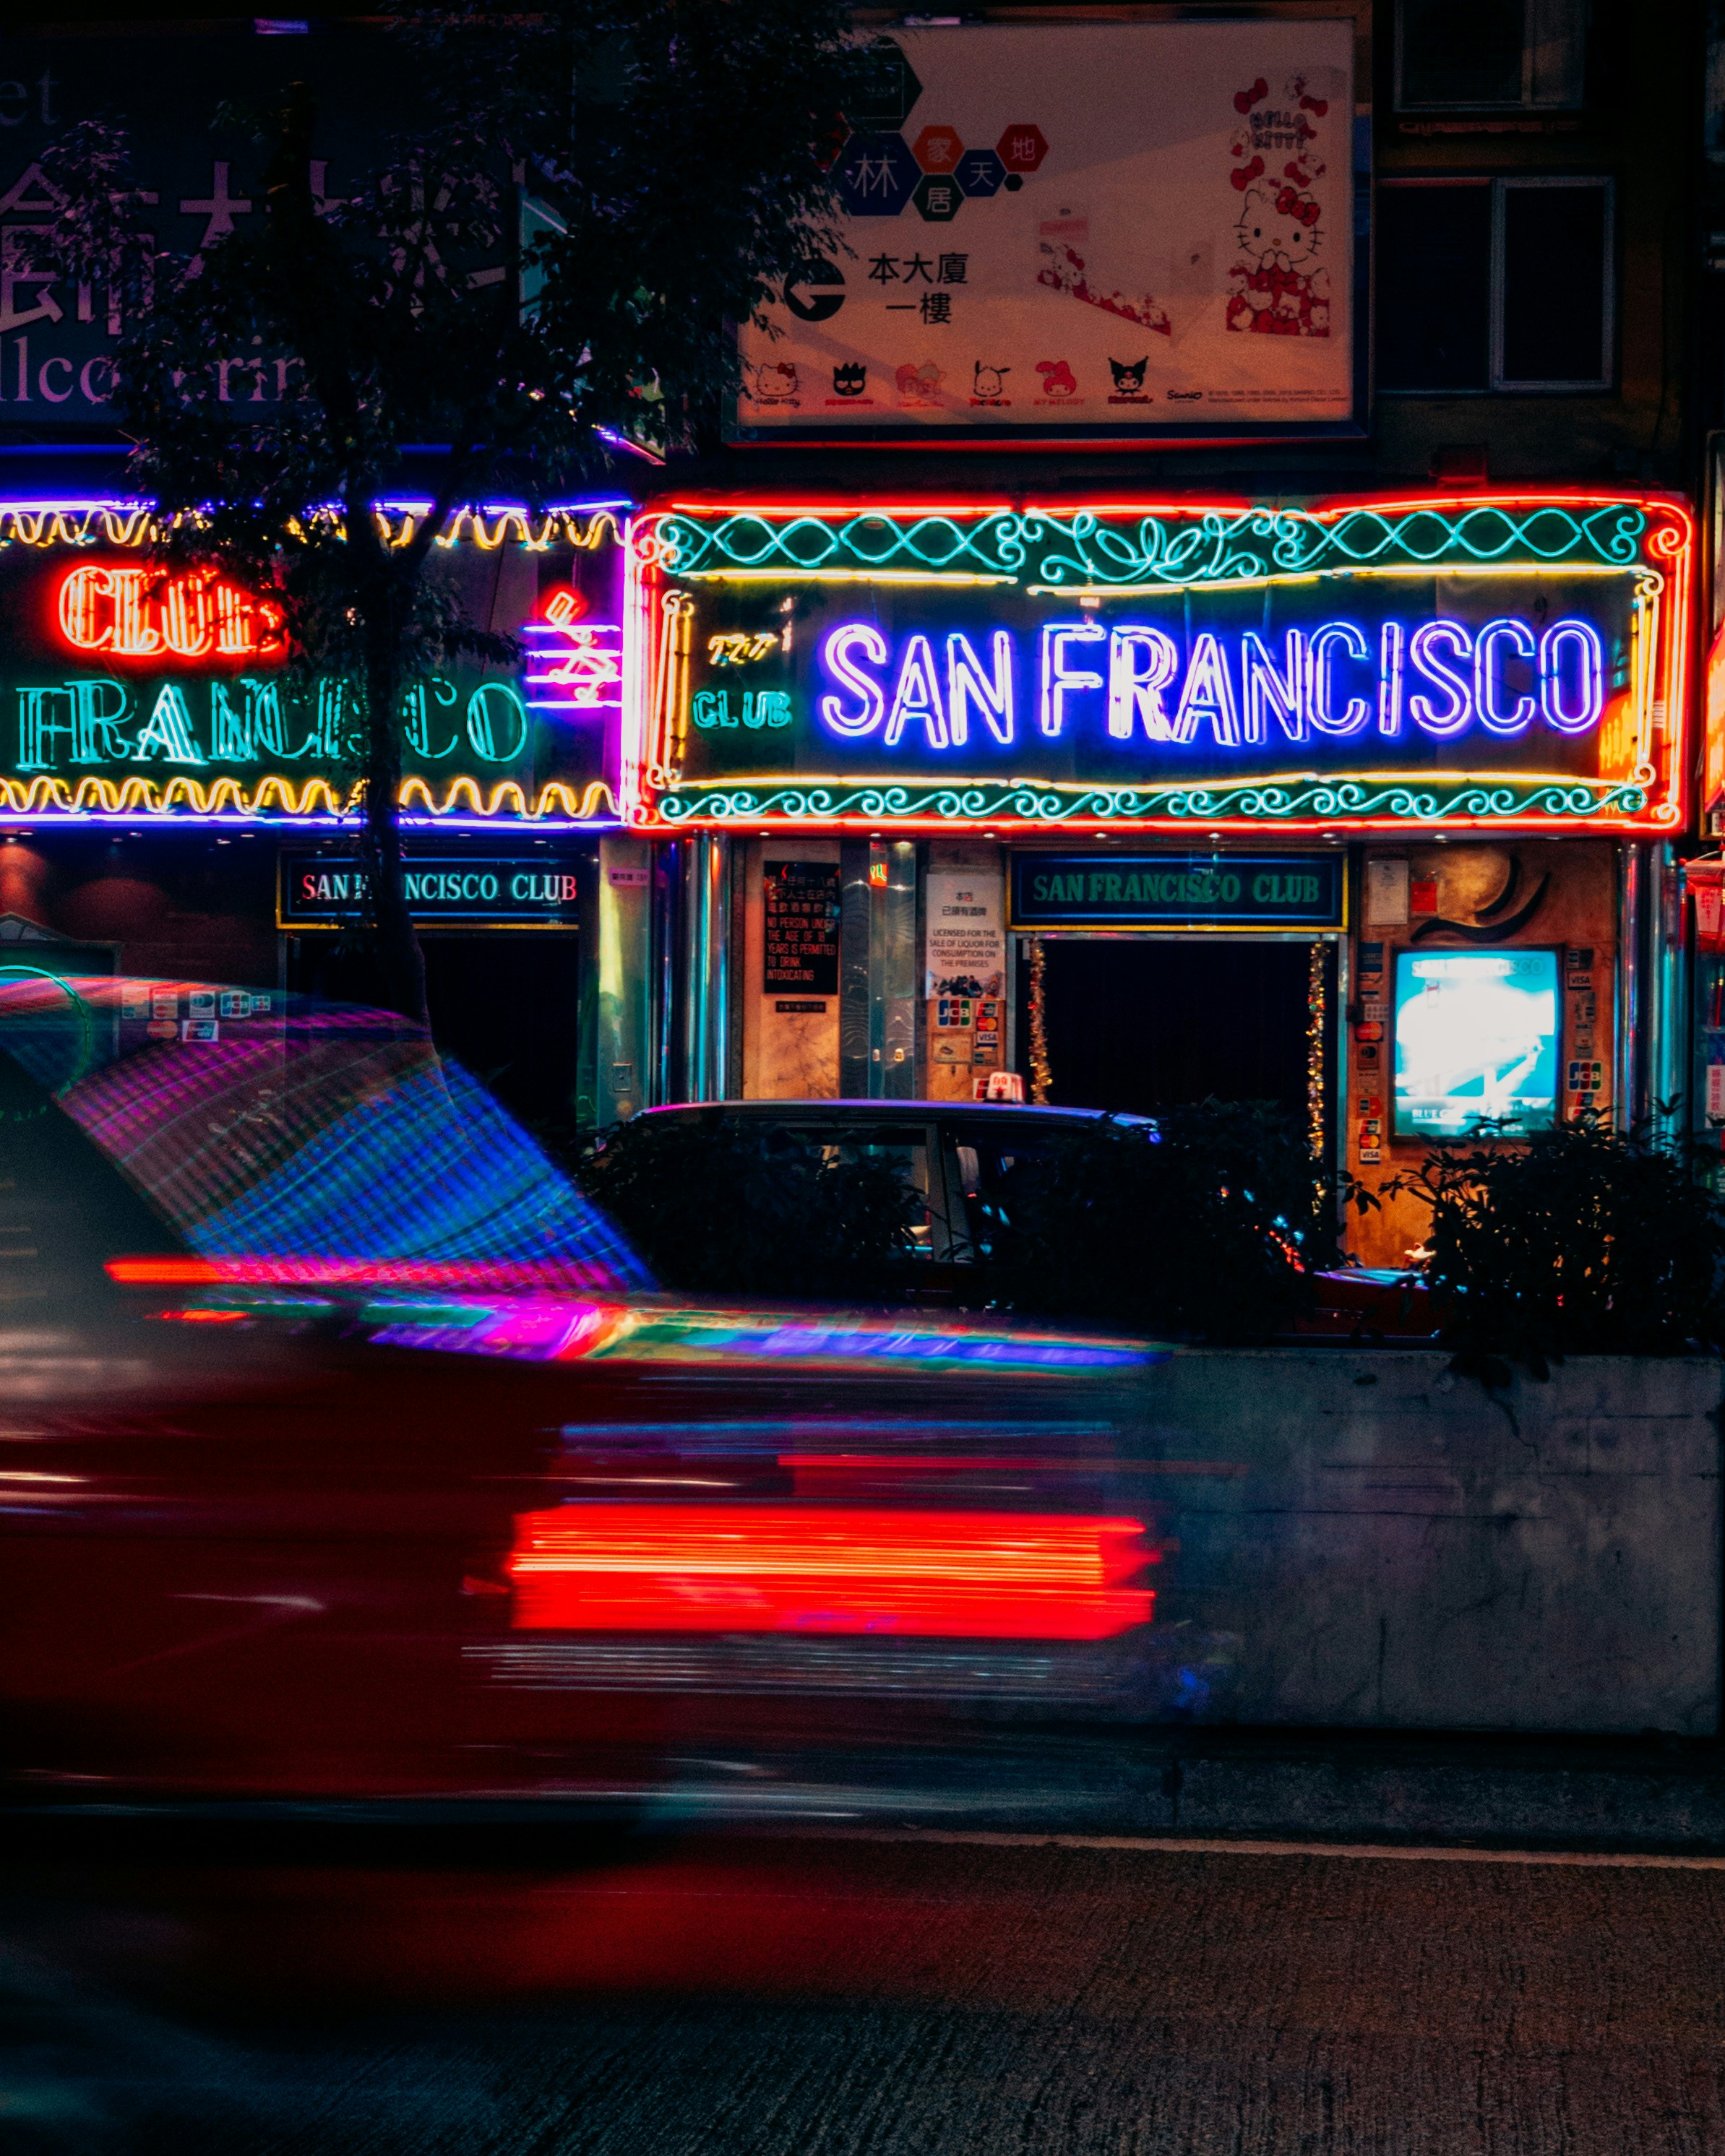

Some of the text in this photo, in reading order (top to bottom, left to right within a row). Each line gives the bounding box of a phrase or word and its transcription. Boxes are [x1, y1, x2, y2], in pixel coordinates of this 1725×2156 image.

[1249, 110, 1307, 130] HELLO
[1251, 131, 1307, 150] KITTY
[869, 253, 969, 285] 本大廈
[886, 292, 952, 325] 一樓
[1167, 390, 1203, 400] Sanrio
[822, 620, 1602, 749] SAN FRANCISCO
[693, 689, 792, 729] CLUB
[16, 677, 528, 770] FRANCICO
[301, 874, 578, 901] SAN FNCISCO CLUB
[1033, 873, 1320, 903] SAN FRANCISCO CLUB
[767, 916, 836, 930] NO PERSON UNDER
[767, 929, 780, 941] THE
[784, 929, 799, 942] AGE
[803, 930, 813, 942] OF
[767, 942, 836, 956] YEARS IS PERMITTED
[932, 949, 983, 958] CONSUMPTION
[767, 955, 801, 968] TO DRINK
[766, 969, 815, 981] INTOXICATING
[939, 1008, 970, 1018] JCB
[1570, 1071, 1601, 1082] JCB
